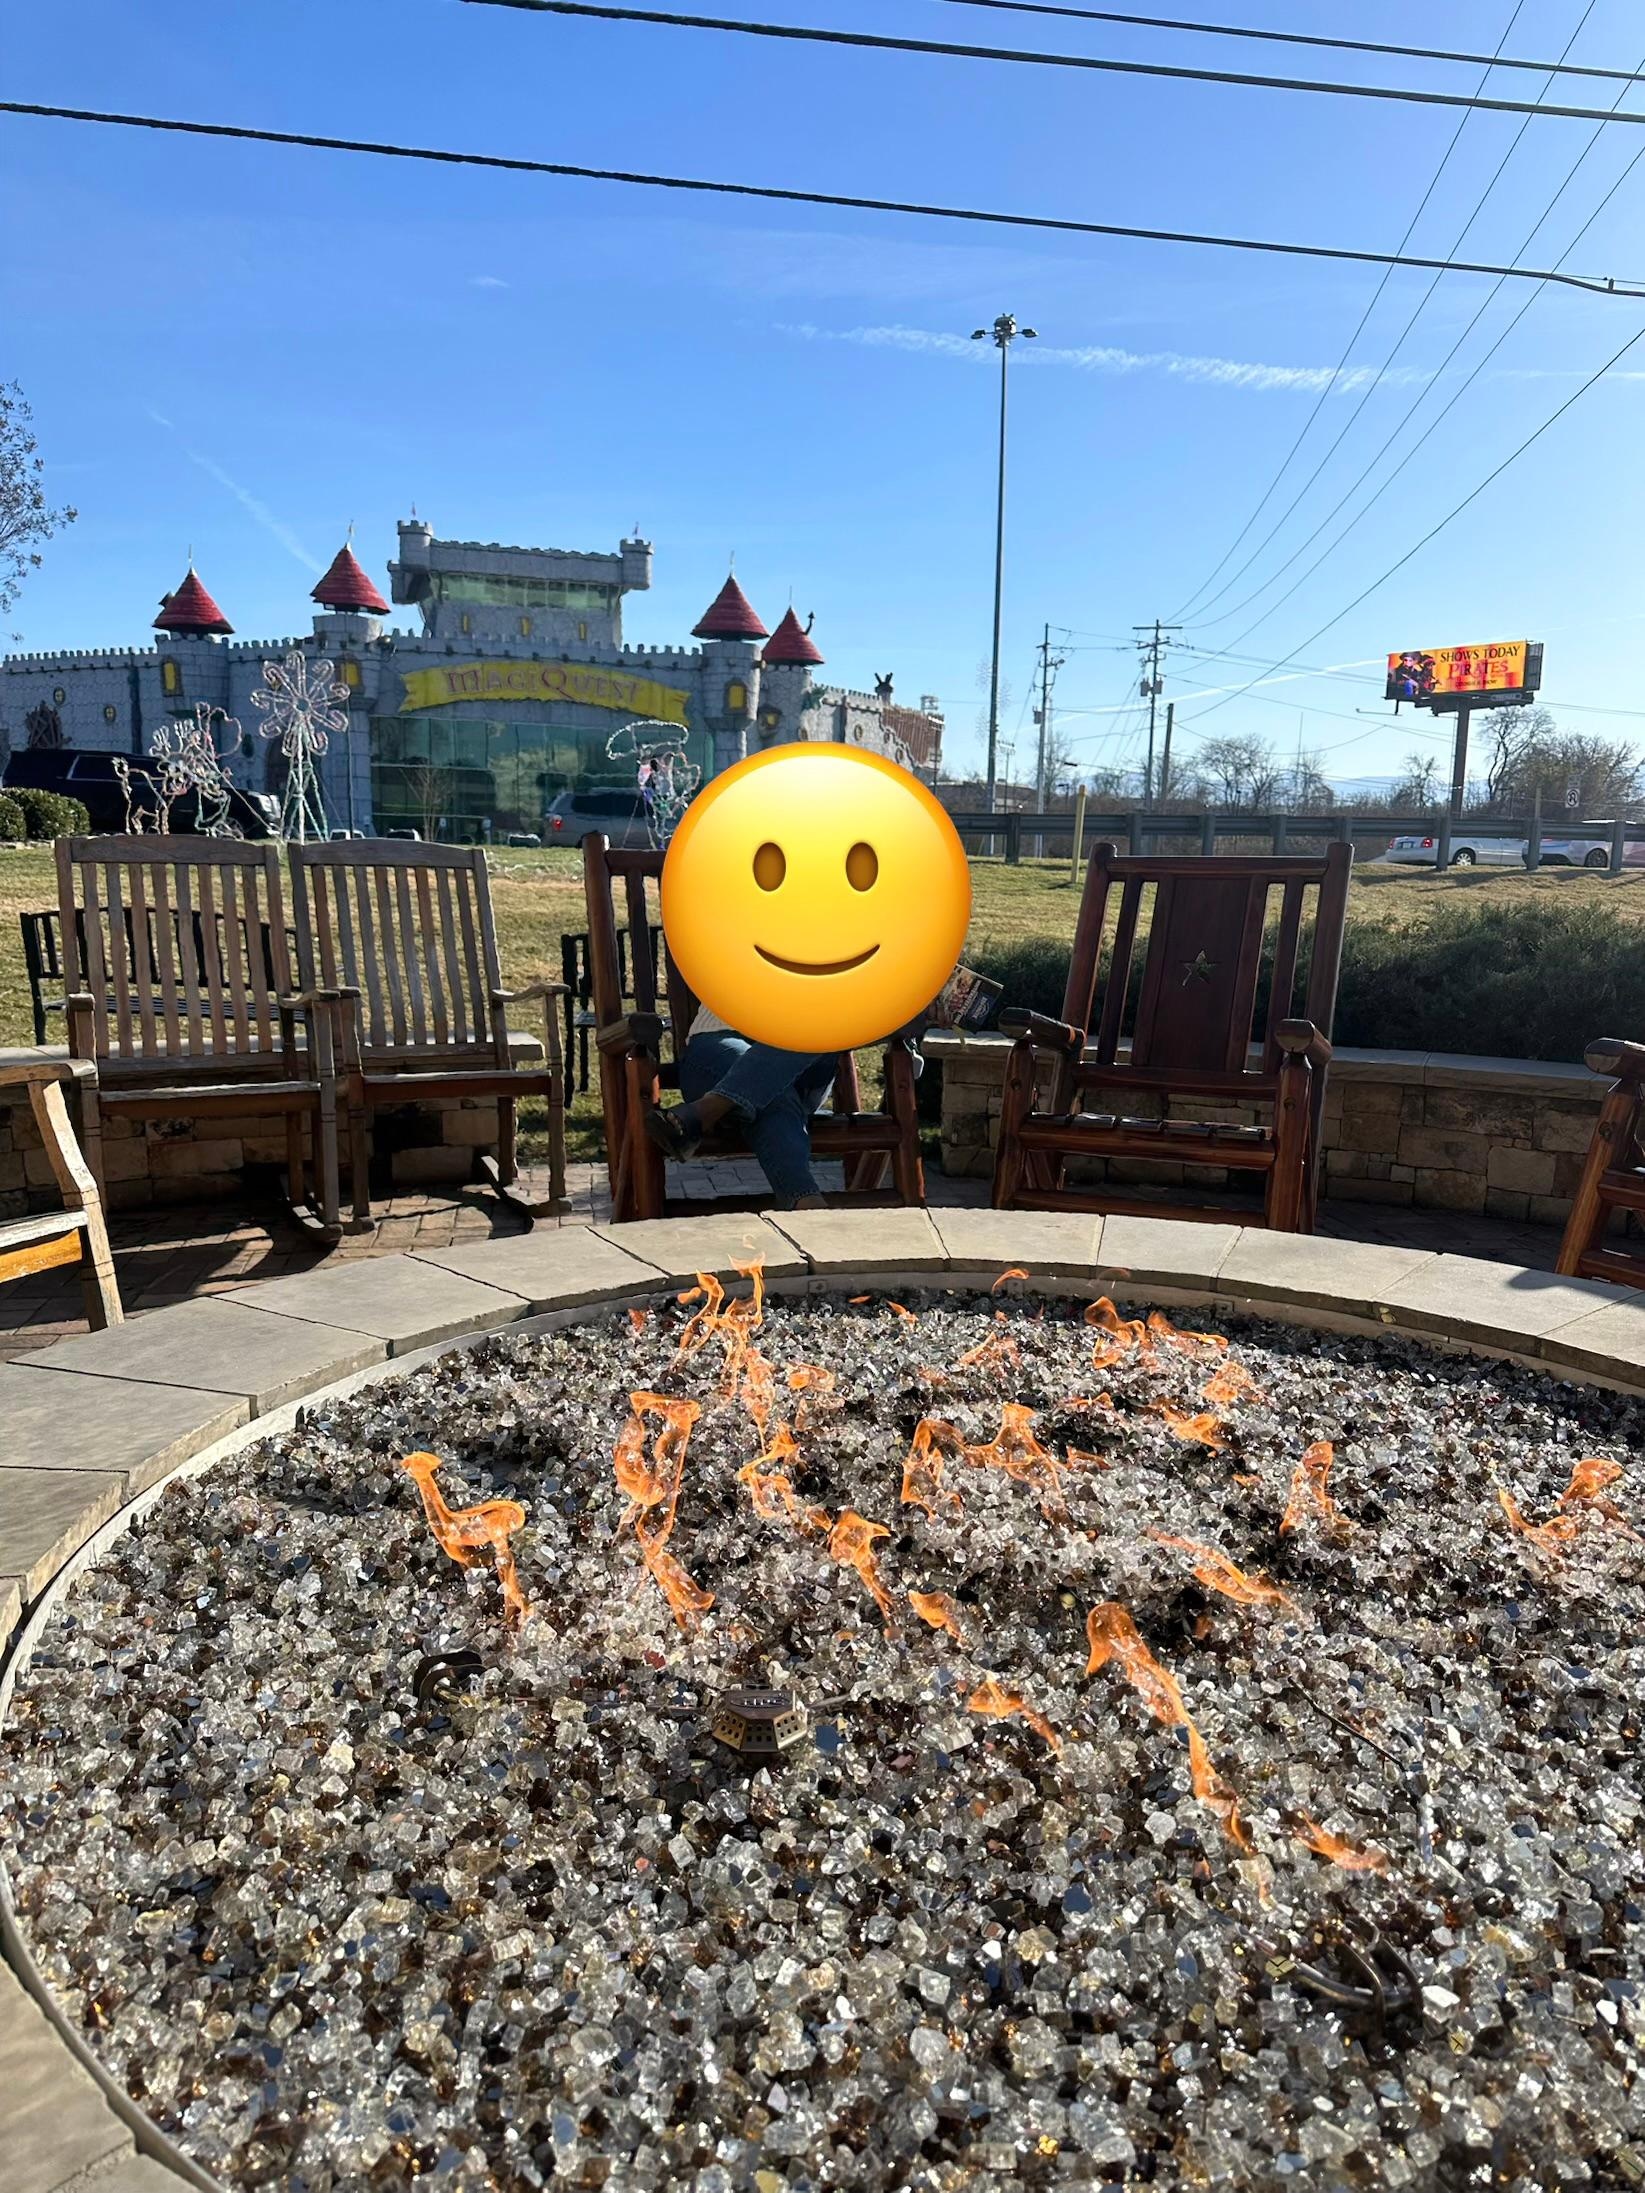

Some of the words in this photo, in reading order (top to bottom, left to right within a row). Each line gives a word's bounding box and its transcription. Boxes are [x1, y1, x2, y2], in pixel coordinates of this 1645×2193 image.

[1440, 648, 1479, 663] SHOWS
[1482, 645, 1520, 658] TODAY
[1447, 660, 1508, 680] PIRATES
